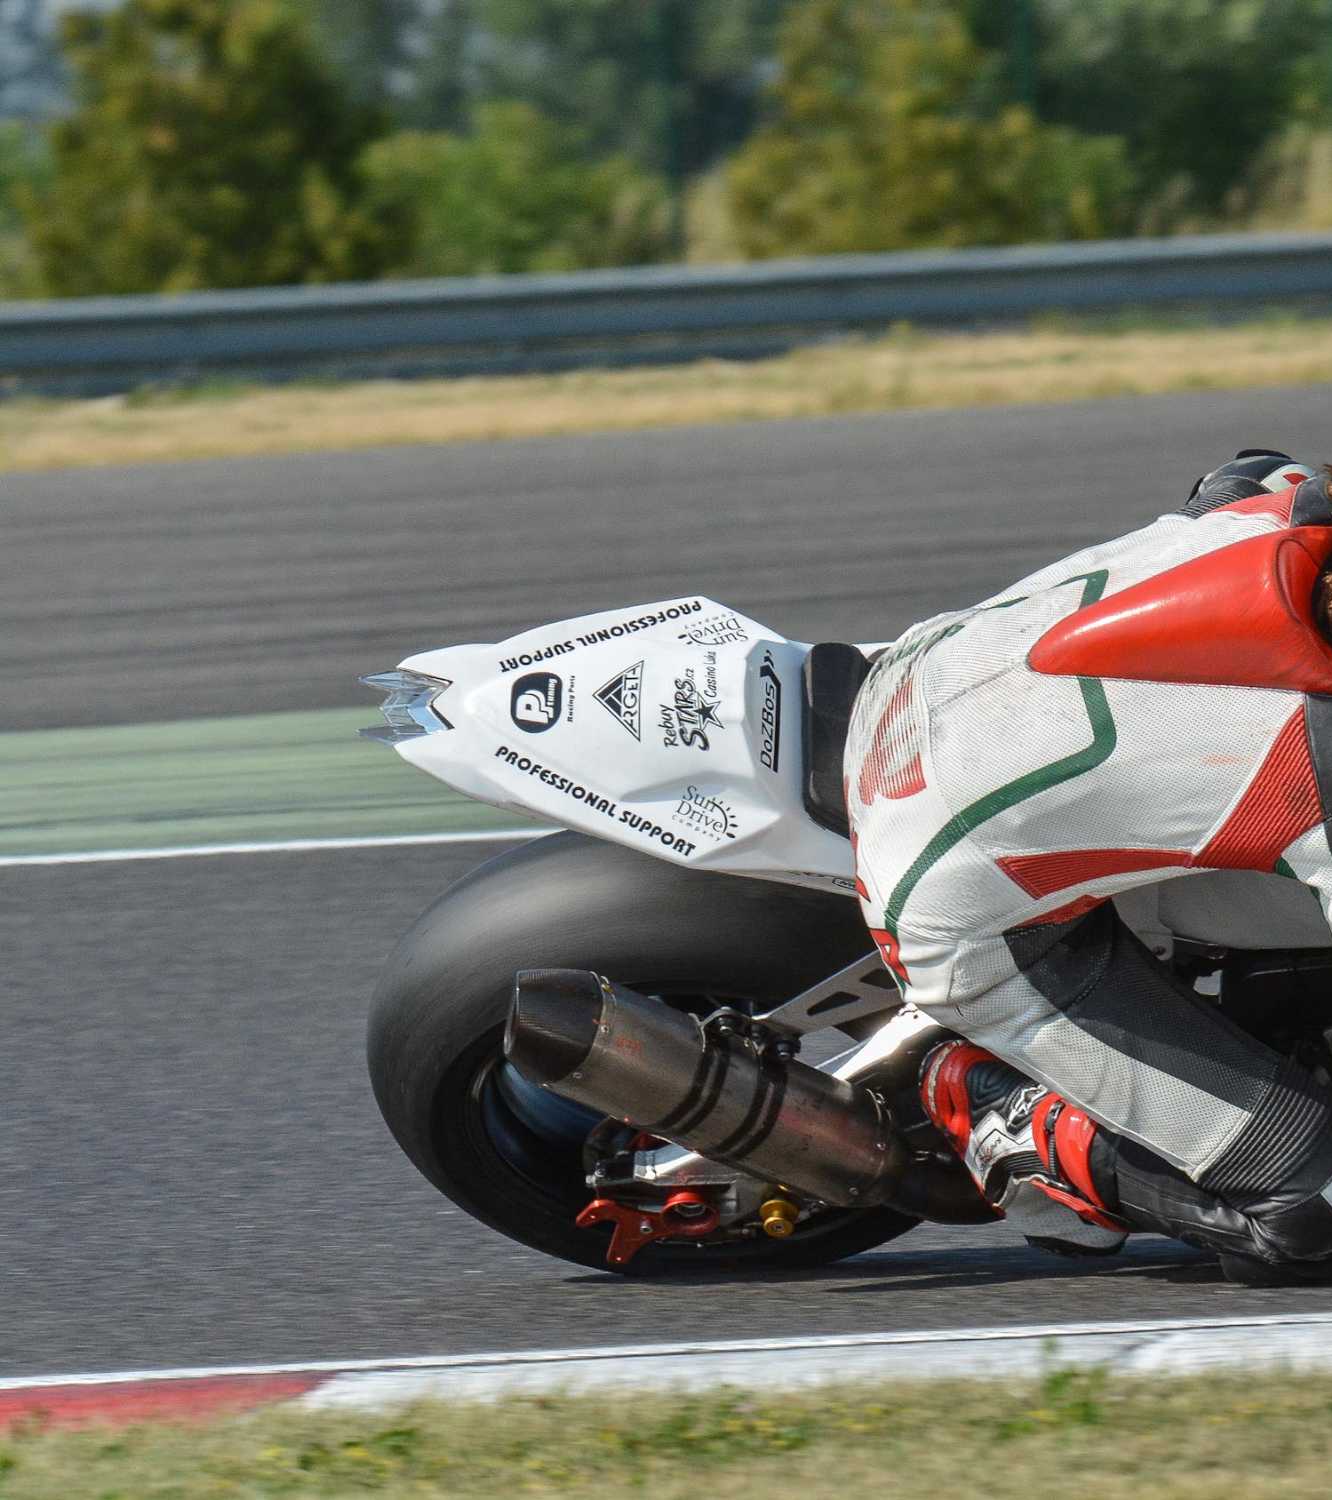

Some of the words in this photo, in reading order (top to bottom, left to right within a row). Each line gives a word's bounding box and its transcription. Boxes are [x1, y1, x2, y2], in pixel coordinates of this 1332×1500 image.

[576, 600, 703, 646] PROFESSIONAL
[695, 617, 742, 640] Drive
[713, 628, 749, 645] Sun
[498, 640, 576, 673] SUPPORT
[704, 666, 717, 698] Casino
[658, 704, 679, 748] Rebuy
[495, 745, 618, 818] PROFESSIONAL
[619, 810, 697, 857] SUPPORT
[682, 785, 718, 813] Sun
[675, 800, 727, 834] Drive
